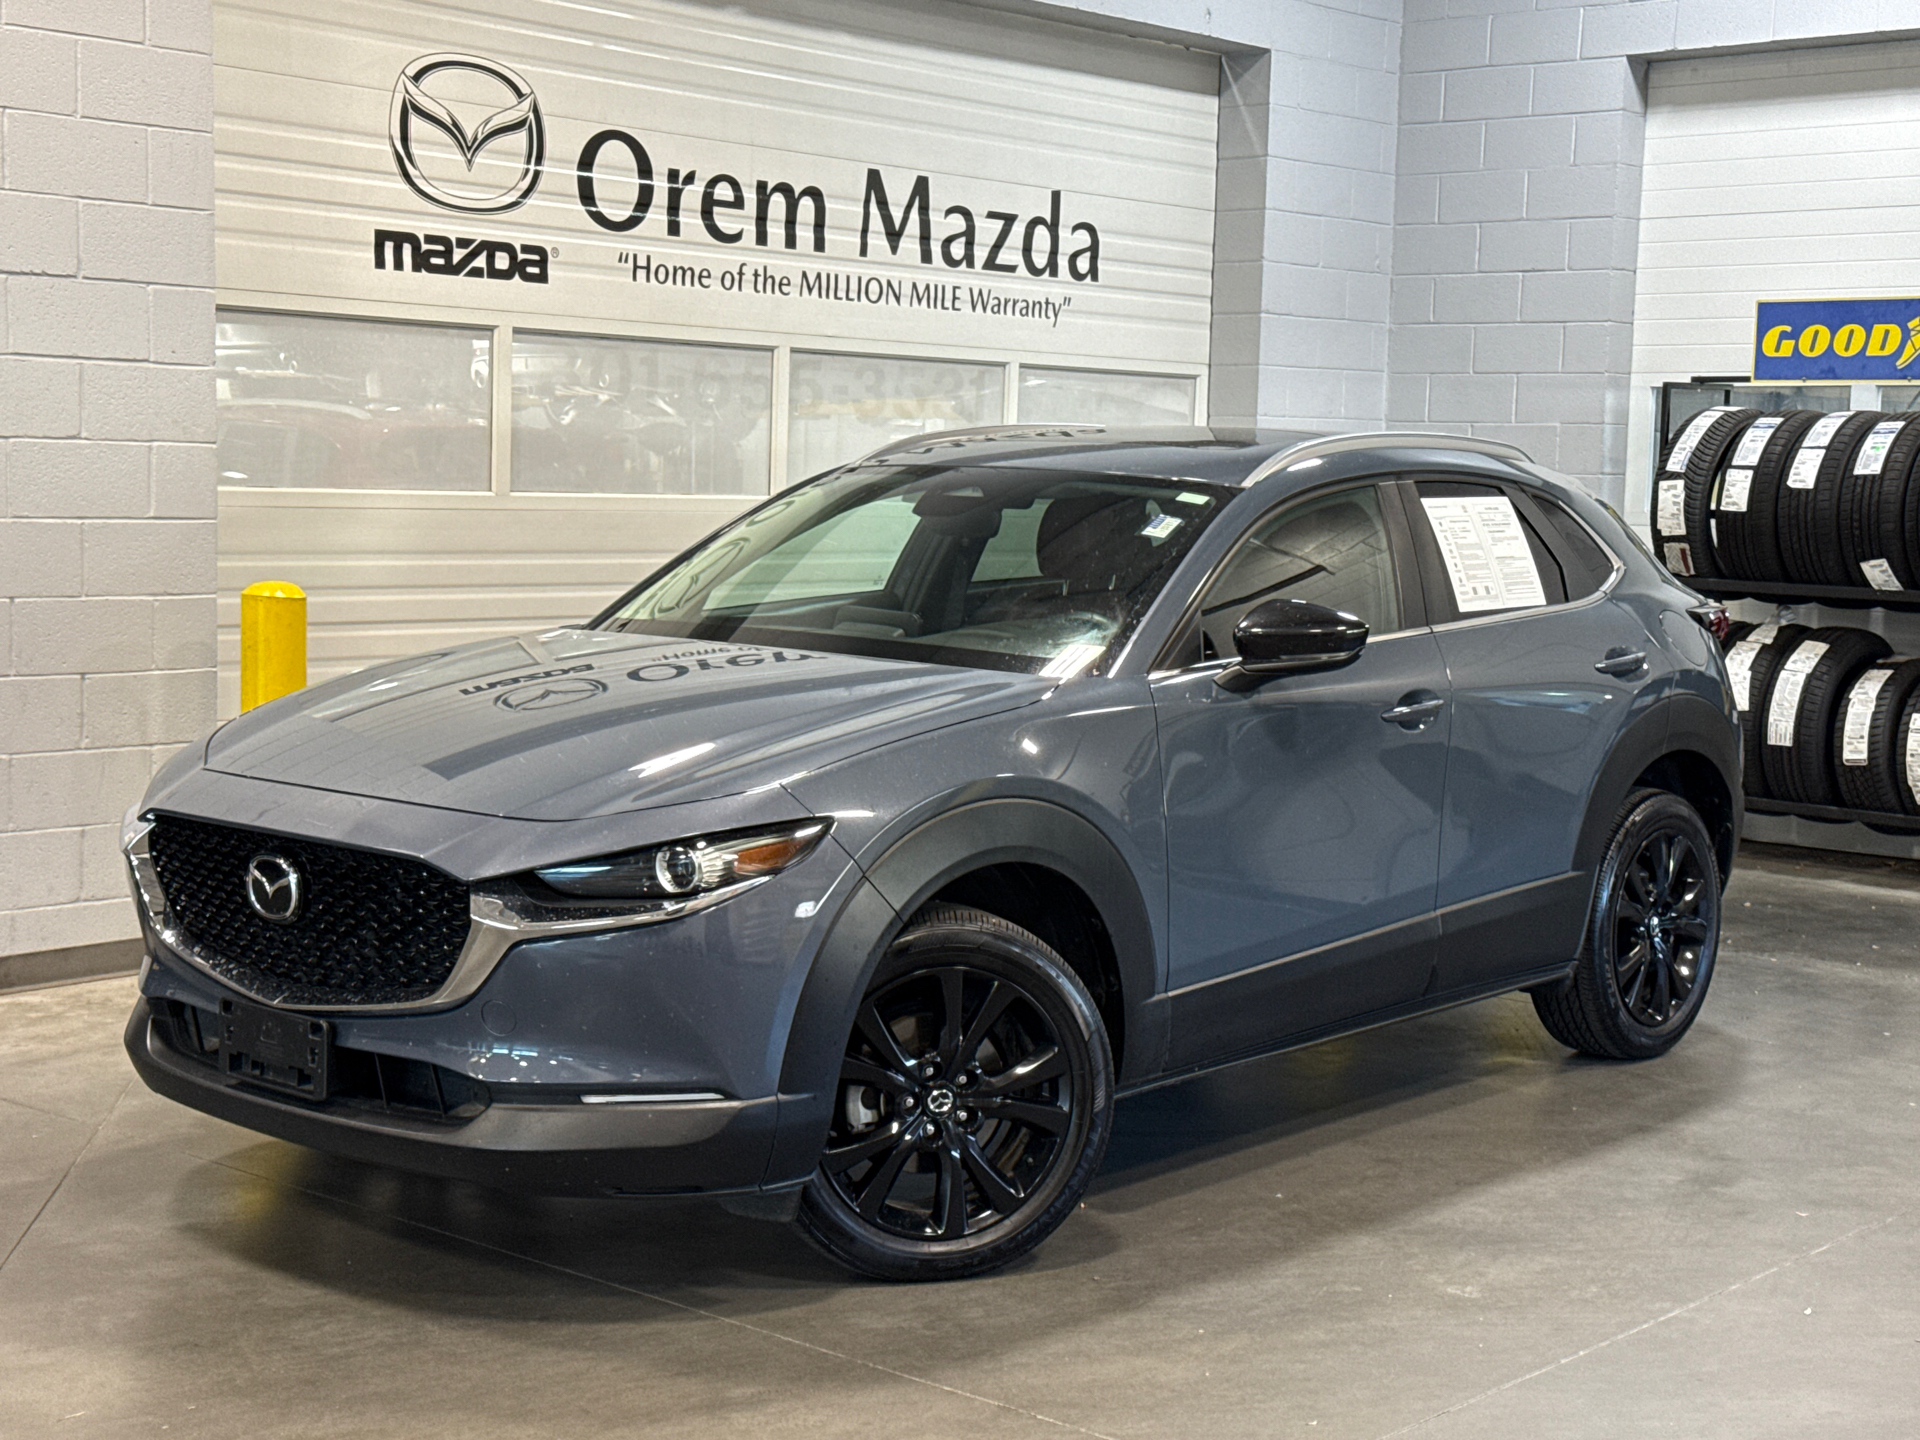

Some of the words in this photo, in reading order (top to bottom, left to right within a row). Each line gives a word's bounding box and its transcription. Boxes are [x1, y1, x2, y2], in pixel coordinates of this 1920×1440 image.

[575, 128, 827, 254] Orem
[859, 167, 1101, 283] Mazda
[617, 251, 712, 289] “Home
[720, 262, 748, 292] of
[752, 265, 792, 296] the
[799, 269, 902, 307] MILLION
[909, 281, 963, 313] MILE
[968, 288, 1072, 327] Warranty”
[1761, 323, 1902, 357] GOOD
